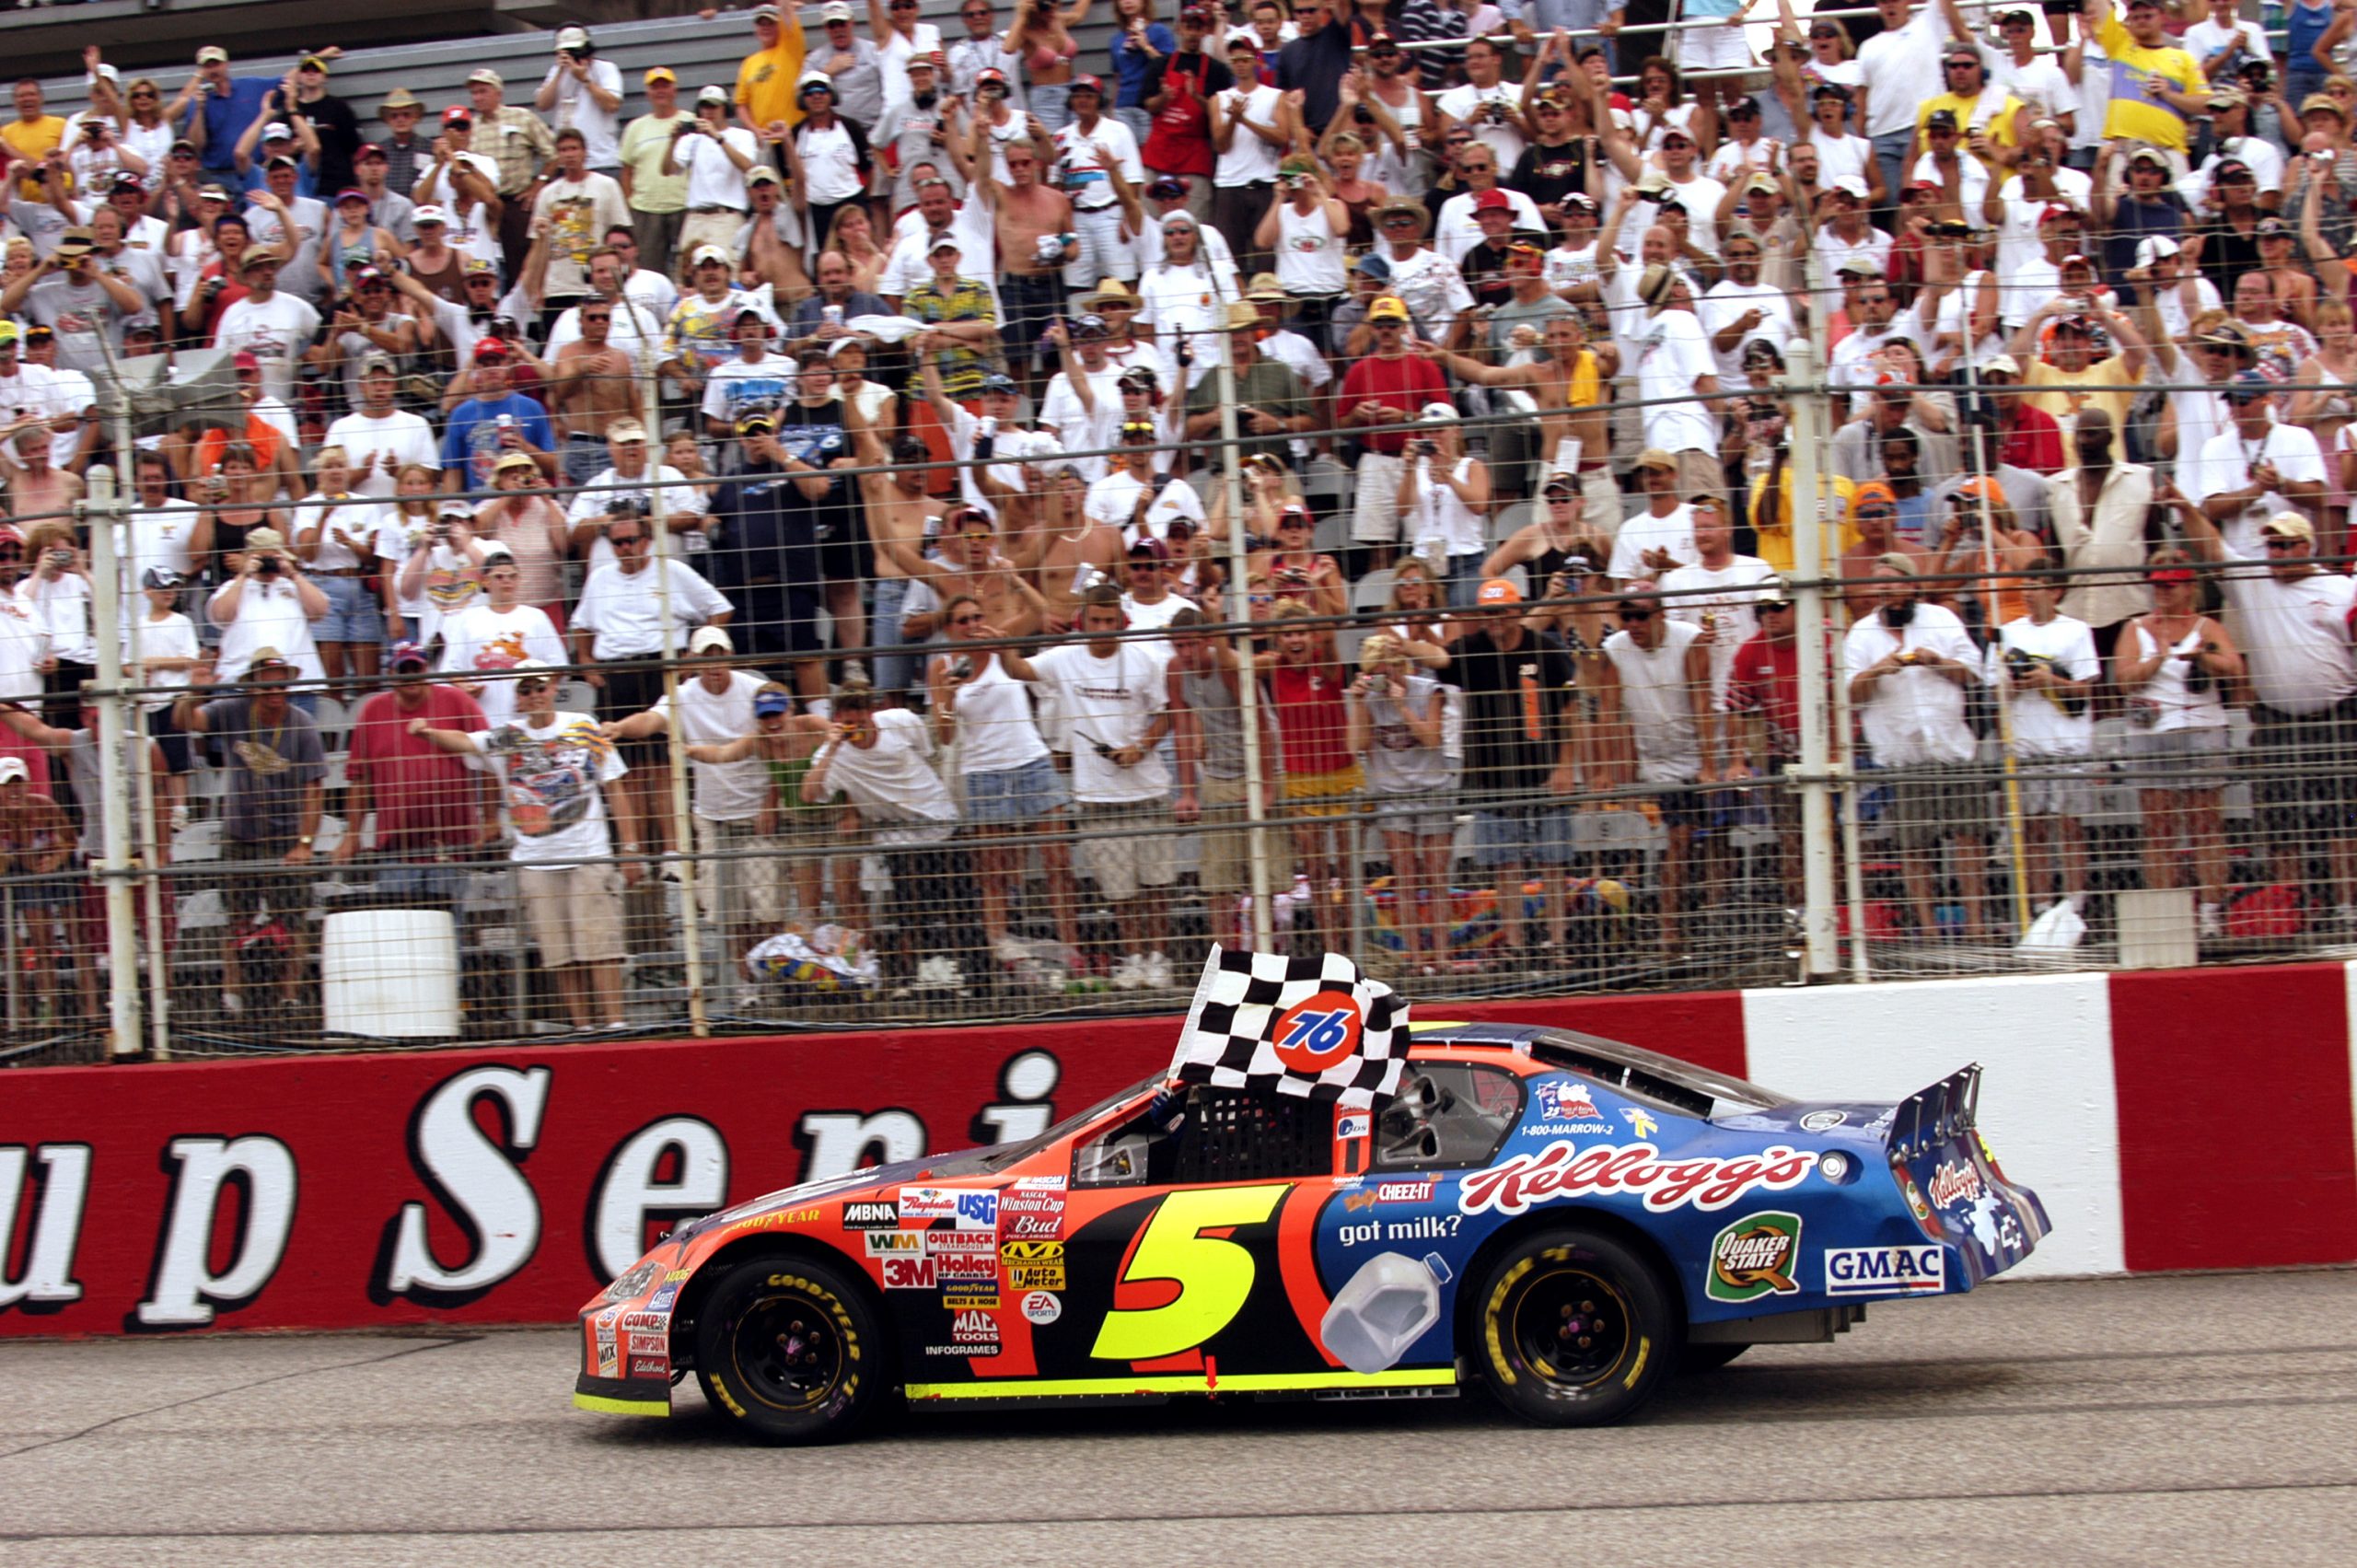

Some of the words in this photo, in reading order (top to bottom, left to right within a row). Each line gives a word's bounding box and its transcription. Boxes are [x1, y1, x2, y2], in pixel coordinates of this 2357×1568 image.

[1277, 1009, 1355, 1055] 76
[1522, 1123, 1614, 1136] 1-800-MARROW-2
[1462, 1143, 1817, 1213] Kellogg's
[1019, 1191, 1048, 1199] NASCAR
[1378, 1182, 1432, 1201] CHEEZ-IT
[844, 1203, 898, 1222] MBNA
[958, 1193, 996, 1225] USG
[1000, 1197, 1041, 1212] Winston
[1042, 1198, 1064, 1214] Cup
[1015, 1215, 1062, 1234] Bud
[1339, 1220, 1382, 1247] got
[1388, 1214, 1462, 1240] milk?
[869, 1234, 919, 1249] WM
[927, 1233, 993, 1244] OUTBACK
[1718, 1232, 1791, 1259] QUAKER
[936, 1255, 996, 1278] Holley
[1724, 1251, 1778, 1271] STATE
[1829, 1249, 1940, 1280] GMAC
[885, 1258, 935, 1287] 3M
[1026, 1268, 1056, 1277] Auto
[1089, 1183, 1290, 1360] 5
[945, 1283, 996, 1294] GOODYEAR
[1024, 1277, 1062, 1288] Meter
[947, 1297, 967, 1306] BELTS
[978, 1297, 997, 1306] HOSE
[1028, 1295, 1055, 1310] EA
[624, 1313, 659, 1328] COMP
[767, 1273, 862, 1362] GOODYEAR
[953, 1309, 999, 1332] MAC
[1027, 1309, 1057, 1318] SPORTS
[631, 1334, 666, 1352] SIMPSON
[954, 1332, 999, 1342] TOOLS
[599, 1344, 616, 1364] WIX
[925, 1344, 999, 1356] INFOGRAMES
